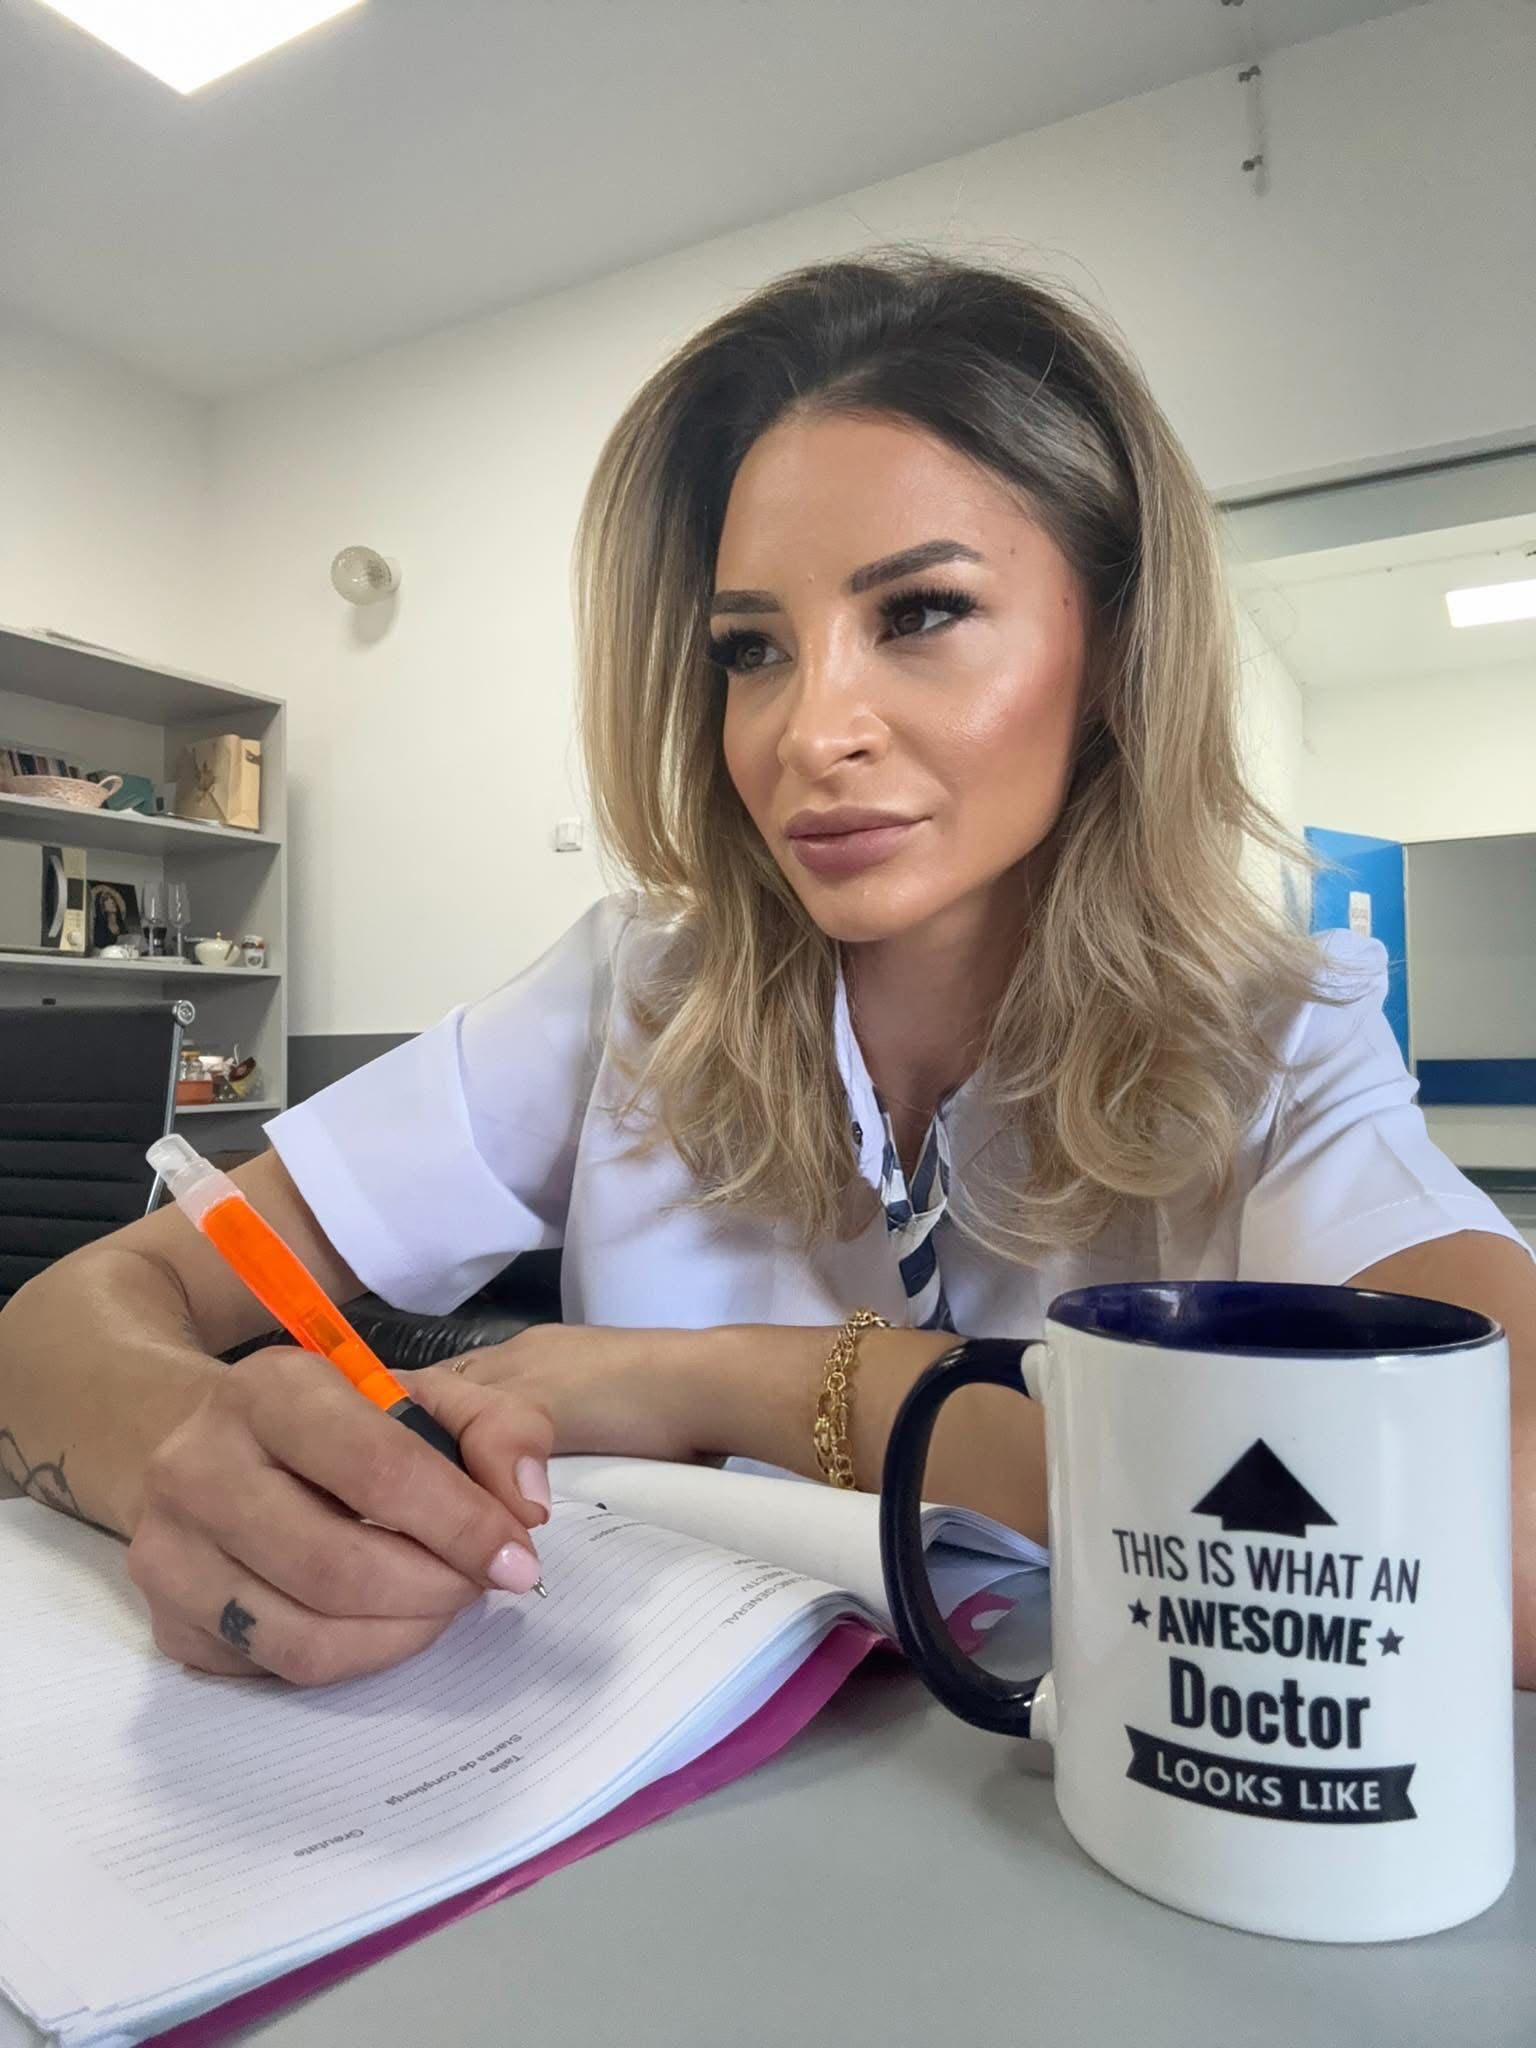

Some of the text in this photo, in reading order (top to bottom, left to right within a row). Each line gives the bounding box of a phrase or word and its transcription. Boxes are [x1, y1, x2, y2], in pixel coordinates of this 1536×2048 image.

[1111, 1528, 1421, 1604] THIS IS WHAT AN
[720, 1587, 777, 1625] GENERAL
[1157, 1595, 1372, 1666] AWESOME
[1168, 1655, 1371, 1750] Doctor
[457, 1758, 477, 1774] de
[476, 1733, 523, 1762] Starea
[488, 1753, 525, 1774] Talie
[1156, 1750, 1382, 1812] LOOKS LIKE
[293, 1827, 365, 1857] Greutate
